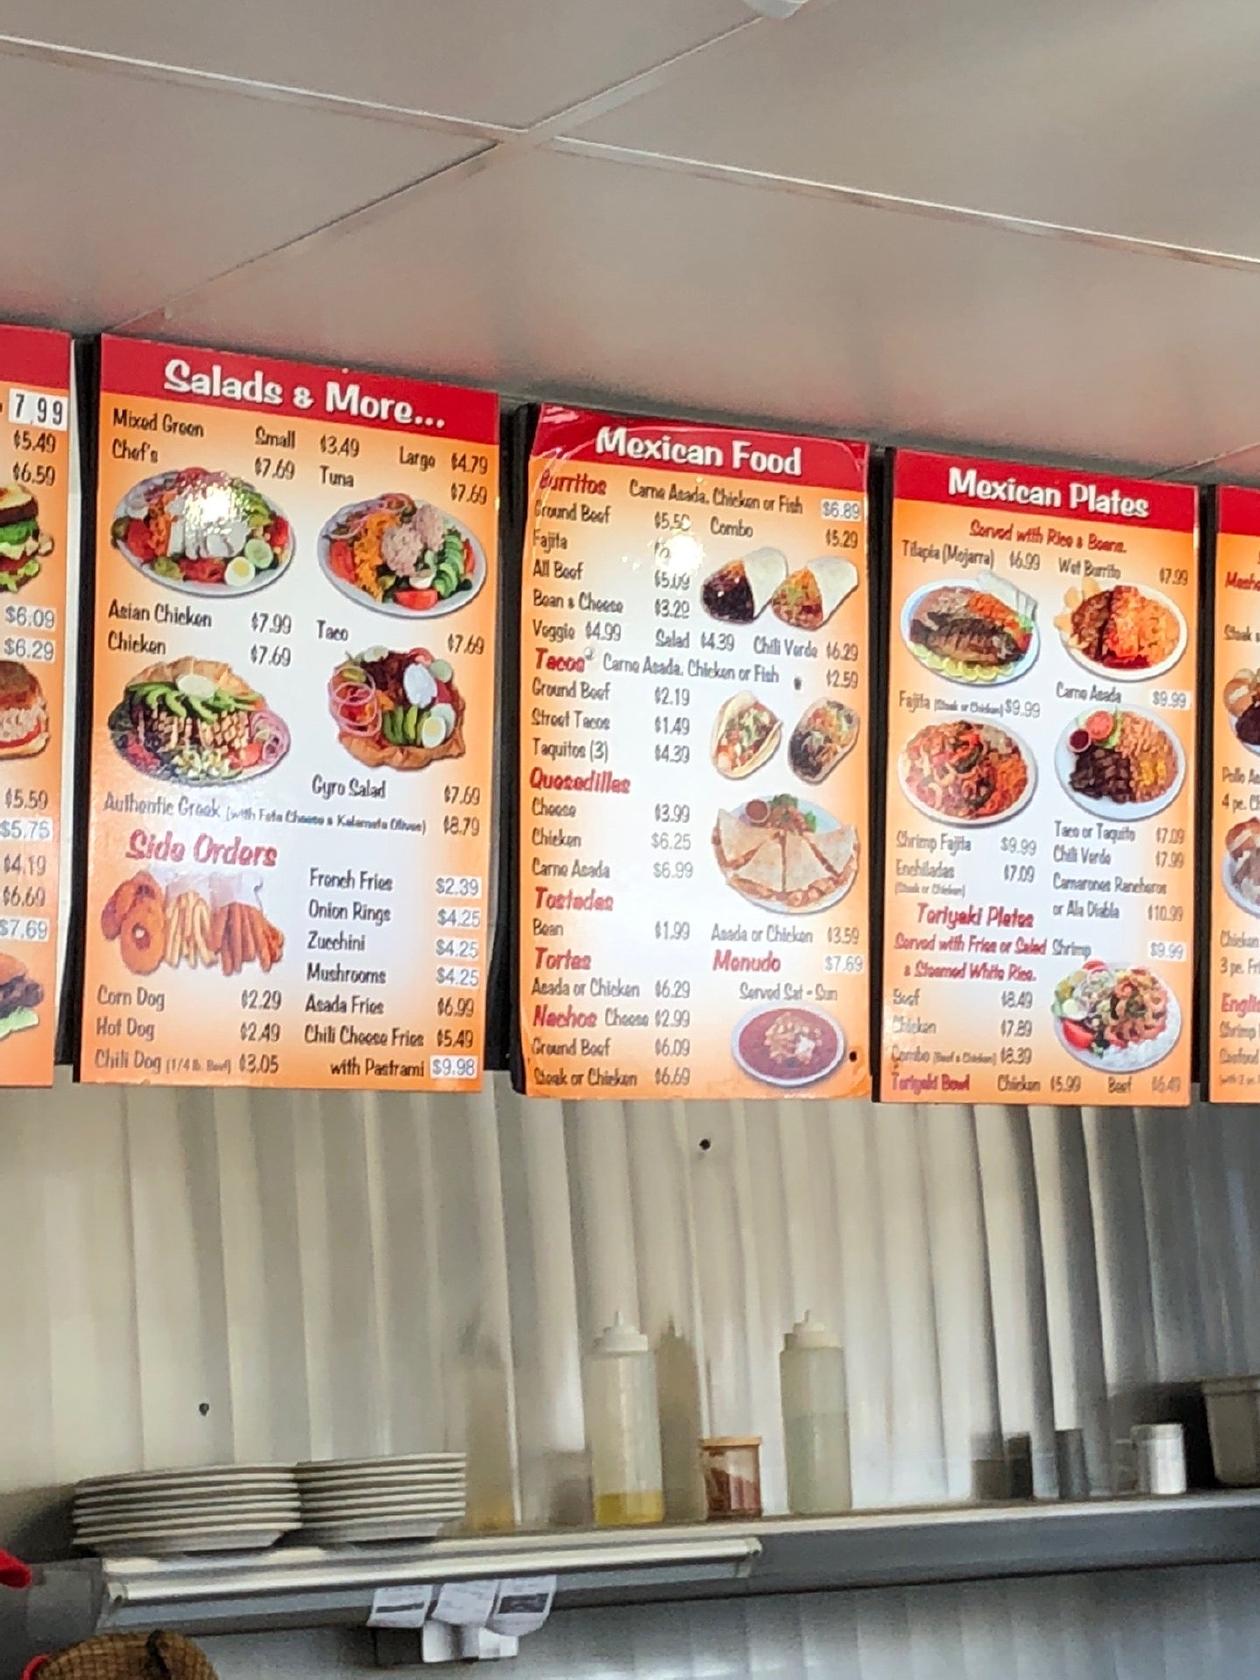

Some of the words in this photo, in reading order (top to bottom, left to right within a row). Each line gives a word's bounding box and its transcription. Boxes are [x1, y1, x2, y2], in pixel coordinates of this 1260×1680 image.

[164, 358, 283, 405] Salads
[293, 387, 314, 409] &
[326, 382, 445, 429] More...
[14, 430, 56, 453] $5.49
[113, 408, 158, 431] Mixed
[162, 414, 204, 437] Green
[255, 426, 295, 449] Small
[320, 435, 360, 457] $3.49
[400, 446, 435, 471] Large
[451, 452, 488, 474] $4.79
[596, 426, 723, 467] Mexican
[732, 440, 802, 476] Food
[319, 465, 354, 487] Tuna
[539, 470, 606, 495] Burritos
[629, 479, 664, 499] Carne
[713, 487, 760, 510] Chicken
[763, 499, 775, 511] or
[779, 495, 803, 513] Fish
[949, 467, 1061, 508] Mexican
[1070, 483, 1149, 518] Plates
[535, 499, 577, 520] Ground
[582, 504, 611, 523] Beef
[710, 516, 753, 538] Combo
[970, 519, 1014, 541] Served
[1017, 527, 1043, 544] with
[1047, 528, 1073, 548] Rice
[902, 540, 940, 563] Tilapia
[533, 559, 549, 577] All
[554, 561, 584, 580] Beef
[1059, 557, 1081, 574] Wet
[1084, 560, 1121, 579] Burrito
[533, 589, 563, 608] Bean
[579, 592, 623, 614] Cheese
[108, 599, 150, 622] Asian
[154, 603, 212, 627] Chicken
[252, 612, 292, 634] $7.99
[108, 630, 166, 655] Chicken
[317, 620, 349, 641] Taco
[533, 619, 575, 643] Veggie
[585, 621, 621, 641] $4.99
[655, 629, 690, 648] Salad
[754, 635, 781, 655] Chili
[784, 639, 818, 658] Verde
[4, 639, 54, 660] $6.29
[535, 647, 585, 672] Tacos
[603, 652, 639, 672] Carne
[688, 659, 735, 680] Chicken
[739, 669, 751, 680] or
[754, 664, 779, 683] Fish
[532, 677, 576, 697] Ground
[581, 682, 611, 700] Beef
[1056, 681, 1087, 699] Carne
[1090, 685, 1121, 703] Asada
[1153, 691, 1186, 708] $9.99
[899, 690, 930, 712] Fajita
[1005, 699, 1040, 718] $9.99
[531, 708, 570, 727] Street
[574, 710, 610, 730] Tacos
[655, 716, 690, 736] $1.49
[533, 738, 586, 760] Taquitos
[590, 740, 609, 763] (3)
[312, 774, 345, 800] Gyro
[349, 778, 386, 798] Salad
[530, 767, 631, 794] Quesadillas
[104, 791, 173, 816] Authentic
[178, 796, 221, 817] Greek
[532, 797, 576, 818] Cheese
[655, 803, 690, 823] $3.99
[532, 828, 581, 848] Chicken
[651, 833, 692, 850] $6.25
[896, 831, 937, 853] Shrimp
[941, 833, 971, 856] Fajita
[1000, 837, 1037, 856] $9.99
[1055, 821, 1079, 838] Taco
[1082, 828, 1092, 838] or
[1096, 823, 1135, 843] Taquito
[125, 829, 186, 862] Side
[194, 832, 278, 867] Orders
[1053, 844, 1078, 863] Chili
[1081, 847, 1111, 865] Verde
[532, 857, 568, 877] Carne
[571, 860, 610, 878] Asada
[653, 862, 693, 879] $6.99
[896, 859, 955, 879] Enchiladas
[310, 868, 355, 890] French
[360, 871, 393, 891] Fries
[435, 878, 479, 896] $2.39
[535, 886, 614, 911] Tostadas
[1053, 904, 1063, 916] or
[308, 900, 348, 920] Onion
[353, 902, 391, 926] Rings
[437, 909, 481, 928] $4.25
[917, 902, 983, 930] Teriyaki
[987, 905, 1034, 928] Plates
[533, 918, 563, 936] Bean
[655, 921, 690, 940] $1.99
[711, 923, 747, 942] Asada
[751, 930, 763, 942] or
[766, 924, 813, 943] Chicken
[894, 933, 936, 950] Served
[307, 930, 365, 951] Zucchini
[436, 939, 479, 959] $4.25
[1052, 939, 1091, 960] Shrimp
[535, 947, 591, 970] Tortas
[713, 949, 781, 972] Menudo
[1220, 957, 1228, 974] 3
[307, 963, 386, 984] Mushrooms
[436, 968, 479, 987] $4.25
[97, 985, 132, 1006] Corn
[137, 987, 165, 1011] Dog
[241, 989, 282, 1011] $2.29
[531, 978, 570, 996] Asada
[573, 983, 586, 996] or
[590, 978, 640, 998] Chicken
[739, 981, 781, 1000] Served
[815, 984, 837, 1000] Sun
[305, 994, 347, 1014] Asada
[352, 995, 384, 1015] Fries
[437, 997, 474, 1017] $6.99
[533, 1004, 597, 1027] Nachos
[605, 1008, 649, 1027] Cheese
[655, 1009, 690, 1027] $2.99
[96, 1017, 121, 1036] Hot
[127, 1018, 155, 1041] Dog
[240, 1022, 281, 1042] $2.49
[305, 1024, 336, 1044] Chili
[340, 1025, 387, 1046] Cheese
[391, 1028, 424, 1047] Fries
[437, 1029, 473, 1049] $5.49
[532, 1037, 577, 1056] Ground
[581, 1037, 611, 1056] Beef
[95, 1049, 129, 1069] Chili
[134, 1051, 161, 1074] Dog
[330, 1059, 360, 1076] with
[365, 1059, 424, 1076] Pastrami
[433, 1058, 475, 1076] $9.98
[571, 1073, 584, 1085] or
[588, 1067, 637, 1086] Chicken
[941, 1074, 970, 1090] Bowl
[998, 1075, 1040, 1092] Chicken
[1108, 1076, 1132, 1093] Beef
